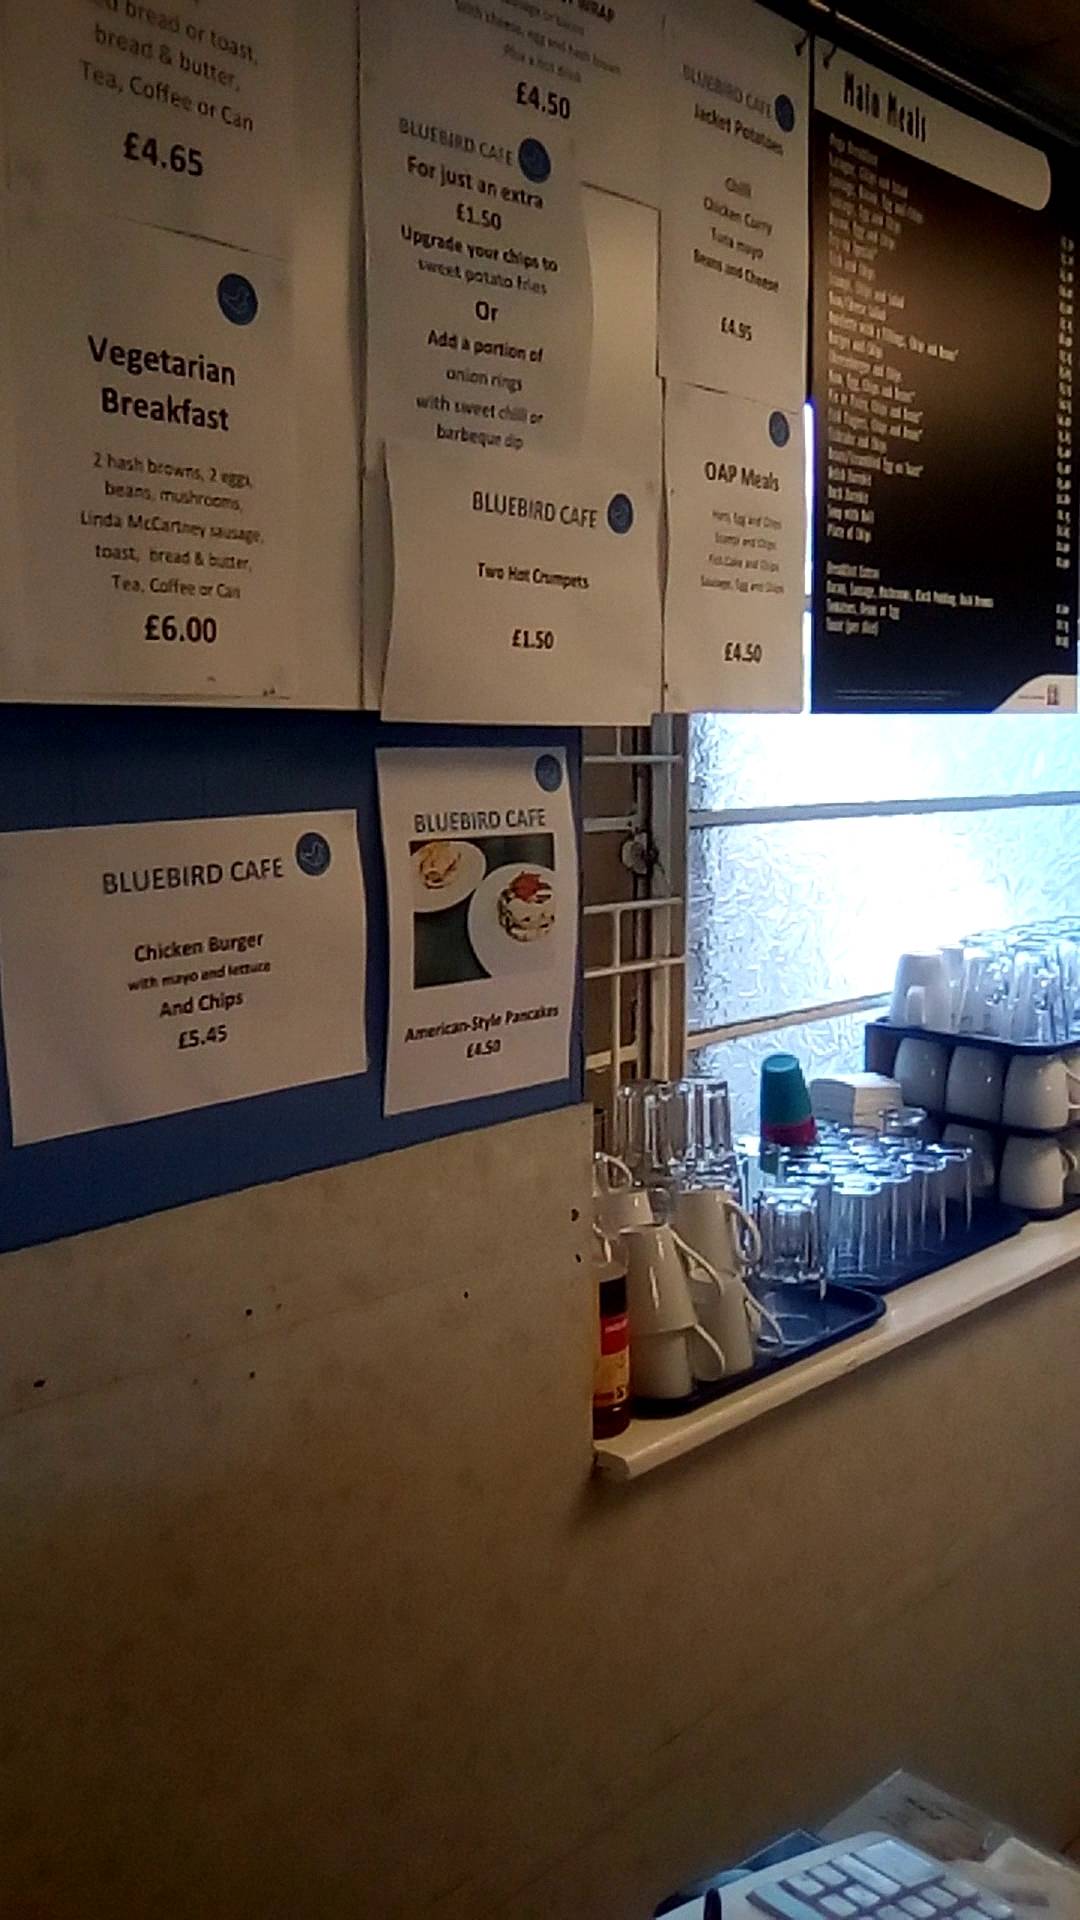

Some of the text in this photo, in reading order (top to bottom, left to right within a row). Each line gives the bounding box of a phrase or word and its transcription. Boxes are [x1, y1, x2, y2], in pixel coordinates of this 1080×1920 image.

[95, 24, 240, 91] bread & butter,
[186, 22, 205, 41] or
[211, 31, 258, 65] toast,
[79, 59, 254, 132] Tea, Coffee or Can
[682, 63, 743, 104] BLUEBIRD
[516, 81, 570, 119] £4.50
[844, 71, 927, 143] Main Meals
[399, 117, 513, 166] BLUEBIRD CAFE
[694, 103, 783, 156] Jacket Potatoes
[123, 132, 203, 177] £4.65
[407, 155, 543, 209] For just an extra
[456, 203, 502, 231] £1.50
[703, 196, 772, 236] Chicken Curry
[401, 223, 558, 273] Upgrade your chips to
[418, 259, 461, 280] sweet
[466, 268, 513, 289] potato
[694, 248, 779, 293] Beans and Cheese
[475, 301, 499, 322] Or
[721, 316, 752, 342] £4.95
[88, 335, 235, 387] Vegetarian
[427, 329, 543, 363] Add a portion of
[446, 367, 522, 392] onion rings
[101, 386, 229, 431] Breakfast
[416, 395, 450, 414] with
[454, 401, 495, 420] sweet
[530, 412, 543, 425] or
[437, 423, 523, 450] barbeque dip
[93, 452, 102, 468] 2
[107, 453, 143, 473] hash
[148, 458, 205, 483] browns,
[209, 467, 217, 483] 2
[704, 460, 780, 492] OAP Meals
[81, 510, 122, 530] Linda
[128, 514, 206, 538] McCartney
[472, 491, 598, 530] BLUEBIRD CAFE
[95, 544, 140, 565] toast,
[150, 549, 190, 566] bread
[194, 553, 204, 567] &
[150, 577, 195, 597] Coffee
[200, 584, 213, 597] or
[216, 583, 241, 600] Can
[478, 562, 589, 590] Two Hot Crumpets
[144, 614, 217, 643] £6.00
[512, 628, 554, 650] £1.50
[724, 642, 762, 664] £4.50
[414, 808, 546, 834] BLUEBIRD CAFE
[103, 857, 283, 896] BLUEBIRD CAFE
[134, 932, 264, 963] Chicken Burger
[128, 961, 271, 992] with mayo and lettuce
[159, 990, 244, 1019] And Chips
[177, 1024, 228, 1050] £5.45
[404, 1004, 559, 1044] American-Style Pancakes
